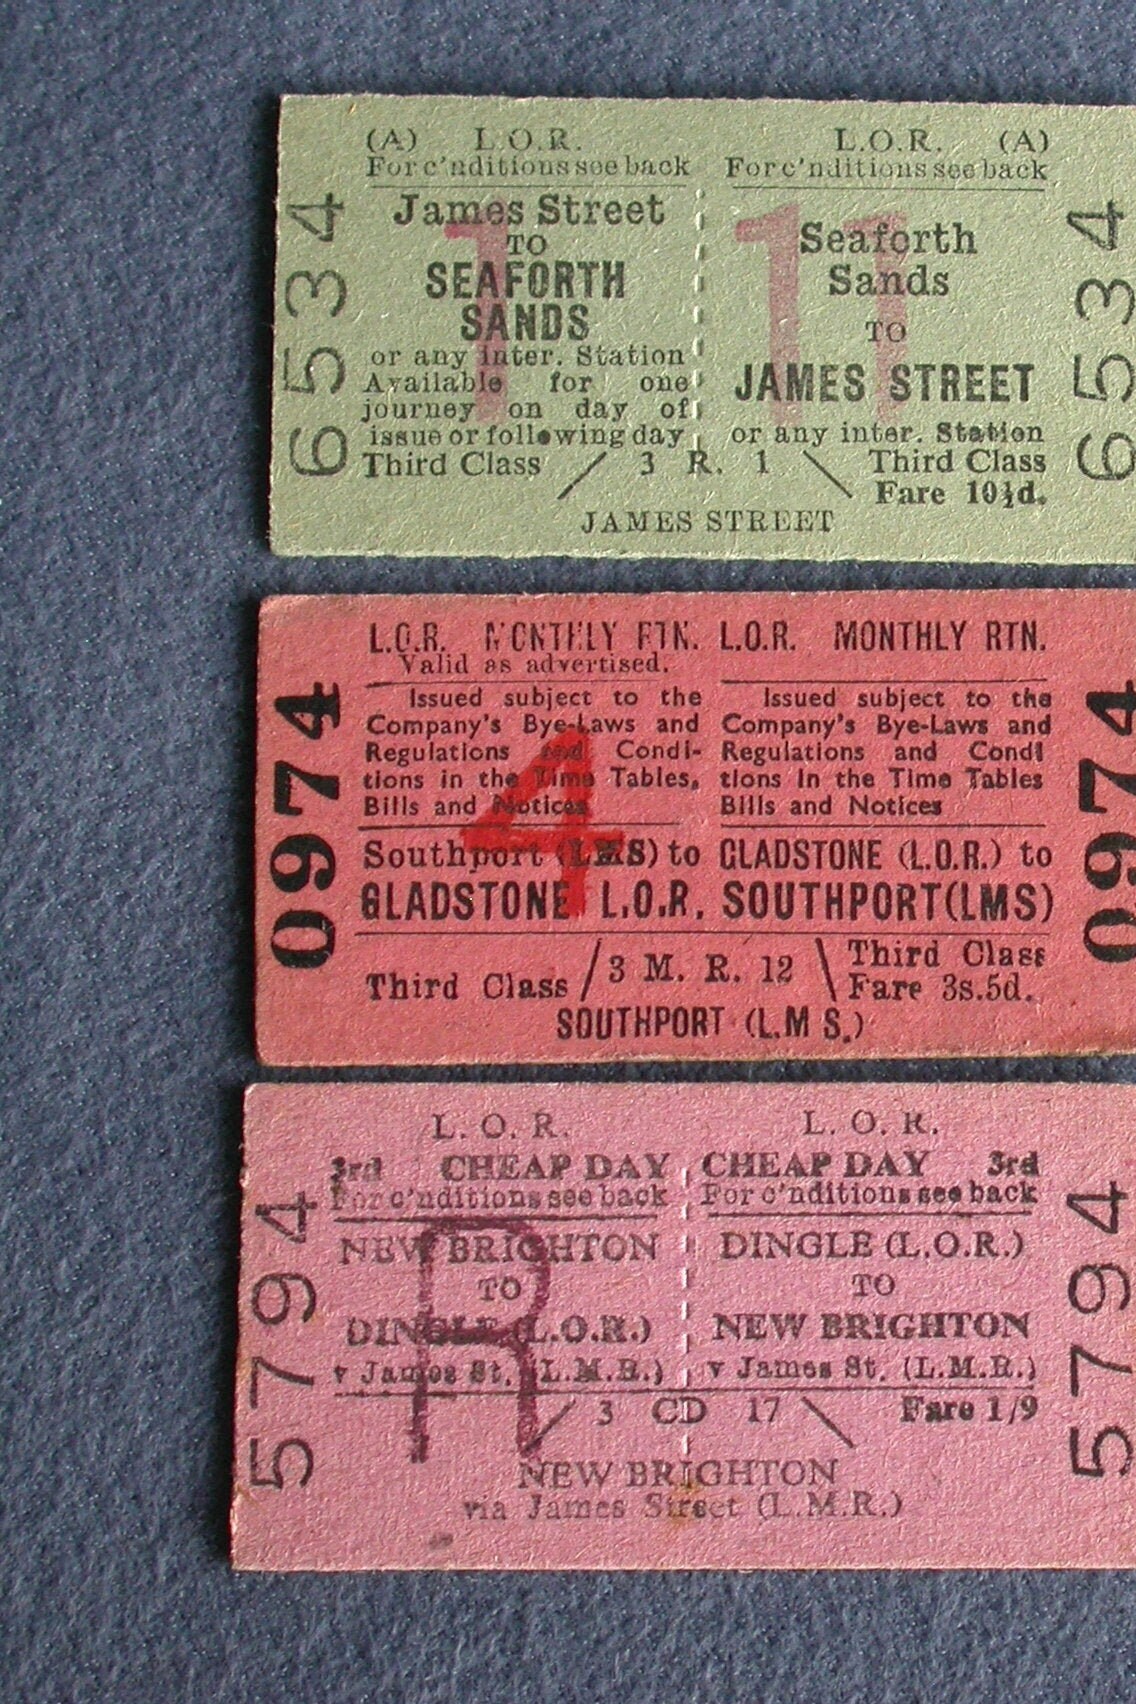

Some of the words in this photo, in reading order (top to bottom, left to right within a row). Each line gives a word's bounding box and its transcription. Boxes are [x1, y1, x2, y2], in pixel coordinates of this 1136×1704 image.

[366, 131, 417, 153] (A)
[835, 128, 942, 152] L.O.R.
[999, 130, 1049, 153] (A)
[393, 193, 524, 225] James
[538, 196, 665, 225] Street
[508, 235, 546, 255] TO
[801, 223, 977, 254] Seaforth
[427, 262, 626, 298] SEAFORTH
[829, 265, 950, 296] Sands
[284, 193, 348, 476] 6534
[461, 305, 590, 341] SANDS
[1066, 201, 1136, 481] 6534
[371, 349, 401, 364] or
[414, 349, 466, 369] any
[481, 346, 563, 365] inter.
[576, 346, 684, 364] Station
[363, 373, 502, 393] Available
[550, 373, 592, 392] for
[640, 377, 689, 392] one
[735, 364, 865, 402] JAMES
[890, 364, 1035, 402] STREET
[361, 403, 474, 424] journey
[509, 404, 542, 418] on
[576, 400, 627, 422] day
[662, 400, 691, 418] of
[371, 427, 442, 446] issue
[450, 432, 479, 446] or
[487, 426, 625, 448] following
[633, 426, 684, 449] day
[362, 452, 447, 477] Third
[461, 452, 541, 475] Class
[869, 450, 954, 473] Third
[966, 449, 1046, 473] Class
[876, 481, 946, 504] Fare
[581, 512, 693, 533] JAMES
[706, 511, 834, 532] STREET
[720, 621, 795, 651] L.O.R.
[835, 621, 967, 651] MONTHLY
[986, 621, 1046, 651] RTN.
[400, 654, 468, 675] Valid
[484, 657, 511, 674] as
[526, 654, 669, 675] advertised.
[763, 689, 836, 707] Issued
[858, 690, 946, 711] subject
[966, 690, 991, 707] to
[1012, 690, 1051, 707] the
[722, 715, 855, 738] Company's
[877, 715, 988, 735] Bye-Laws
[1008, 715, 1051, 734] and
[722, 742, 865, 766] Regulations
[895, 743, 937, 761] and
[720, 769, 781, 788] tions
[797, 771, 820, 787] in
[836, 769, 874, 787] the
[889, 768, 951, 788] Time
[965, 768, 1043, 788] Tables
[720, 797, 775, 816] Bills
[790, 798, 832, 815] and
[849, 797, 941, 816] Notices
[270, 682, 341, 969] 0974
[461, 728, 625, 917] 4
[900, 839, 1001, 870] (L.O.R.)
[1020, 841, 1051, 865] to
[362, 881, 570, 920] GLADSTONE
[600, 880, 704, 919] L.O.R.
[848, 941, 939, 968] Third
[366, 974, 458, 1001] Third
[483, 974, 567, 999] Class
[849, 974, 922, 1000] Fare
[943, 975, 1034, 1001] 3s.5d.
[557, 1008, 732, 1039] SOUTHPORT
[441, 1155, 571, 1182] CHEAP
[585, 1154, 670, 1180] DAY
[702, 1152, 833, 1178] CHEAP
[844, 1151, 929, 1176] DAY
[448, 1234, 659, 1262] BRIGHTON
[720, 1231, 873, 1259] DINGLE
[886, 1231, 1024, 1259] (L.O.R.)
[712, 1314, 807, 1340] NEW
[821, 1312, 1030, 1340] BRIGHTON
[1066, 1181, 1133, 1477] 5794
[251, 1193, 317, 1489] 5794
[411, 1217, 551, 1464] R
[736, 1357, 832, 1379] James
[900, 1396, 974, 1422] Fare
[987, 1396, 1038, 1424] 1/9
[519, 1462, 611, 1489] NEW
[626, 1460, 838, 1489] BRIGHTON
